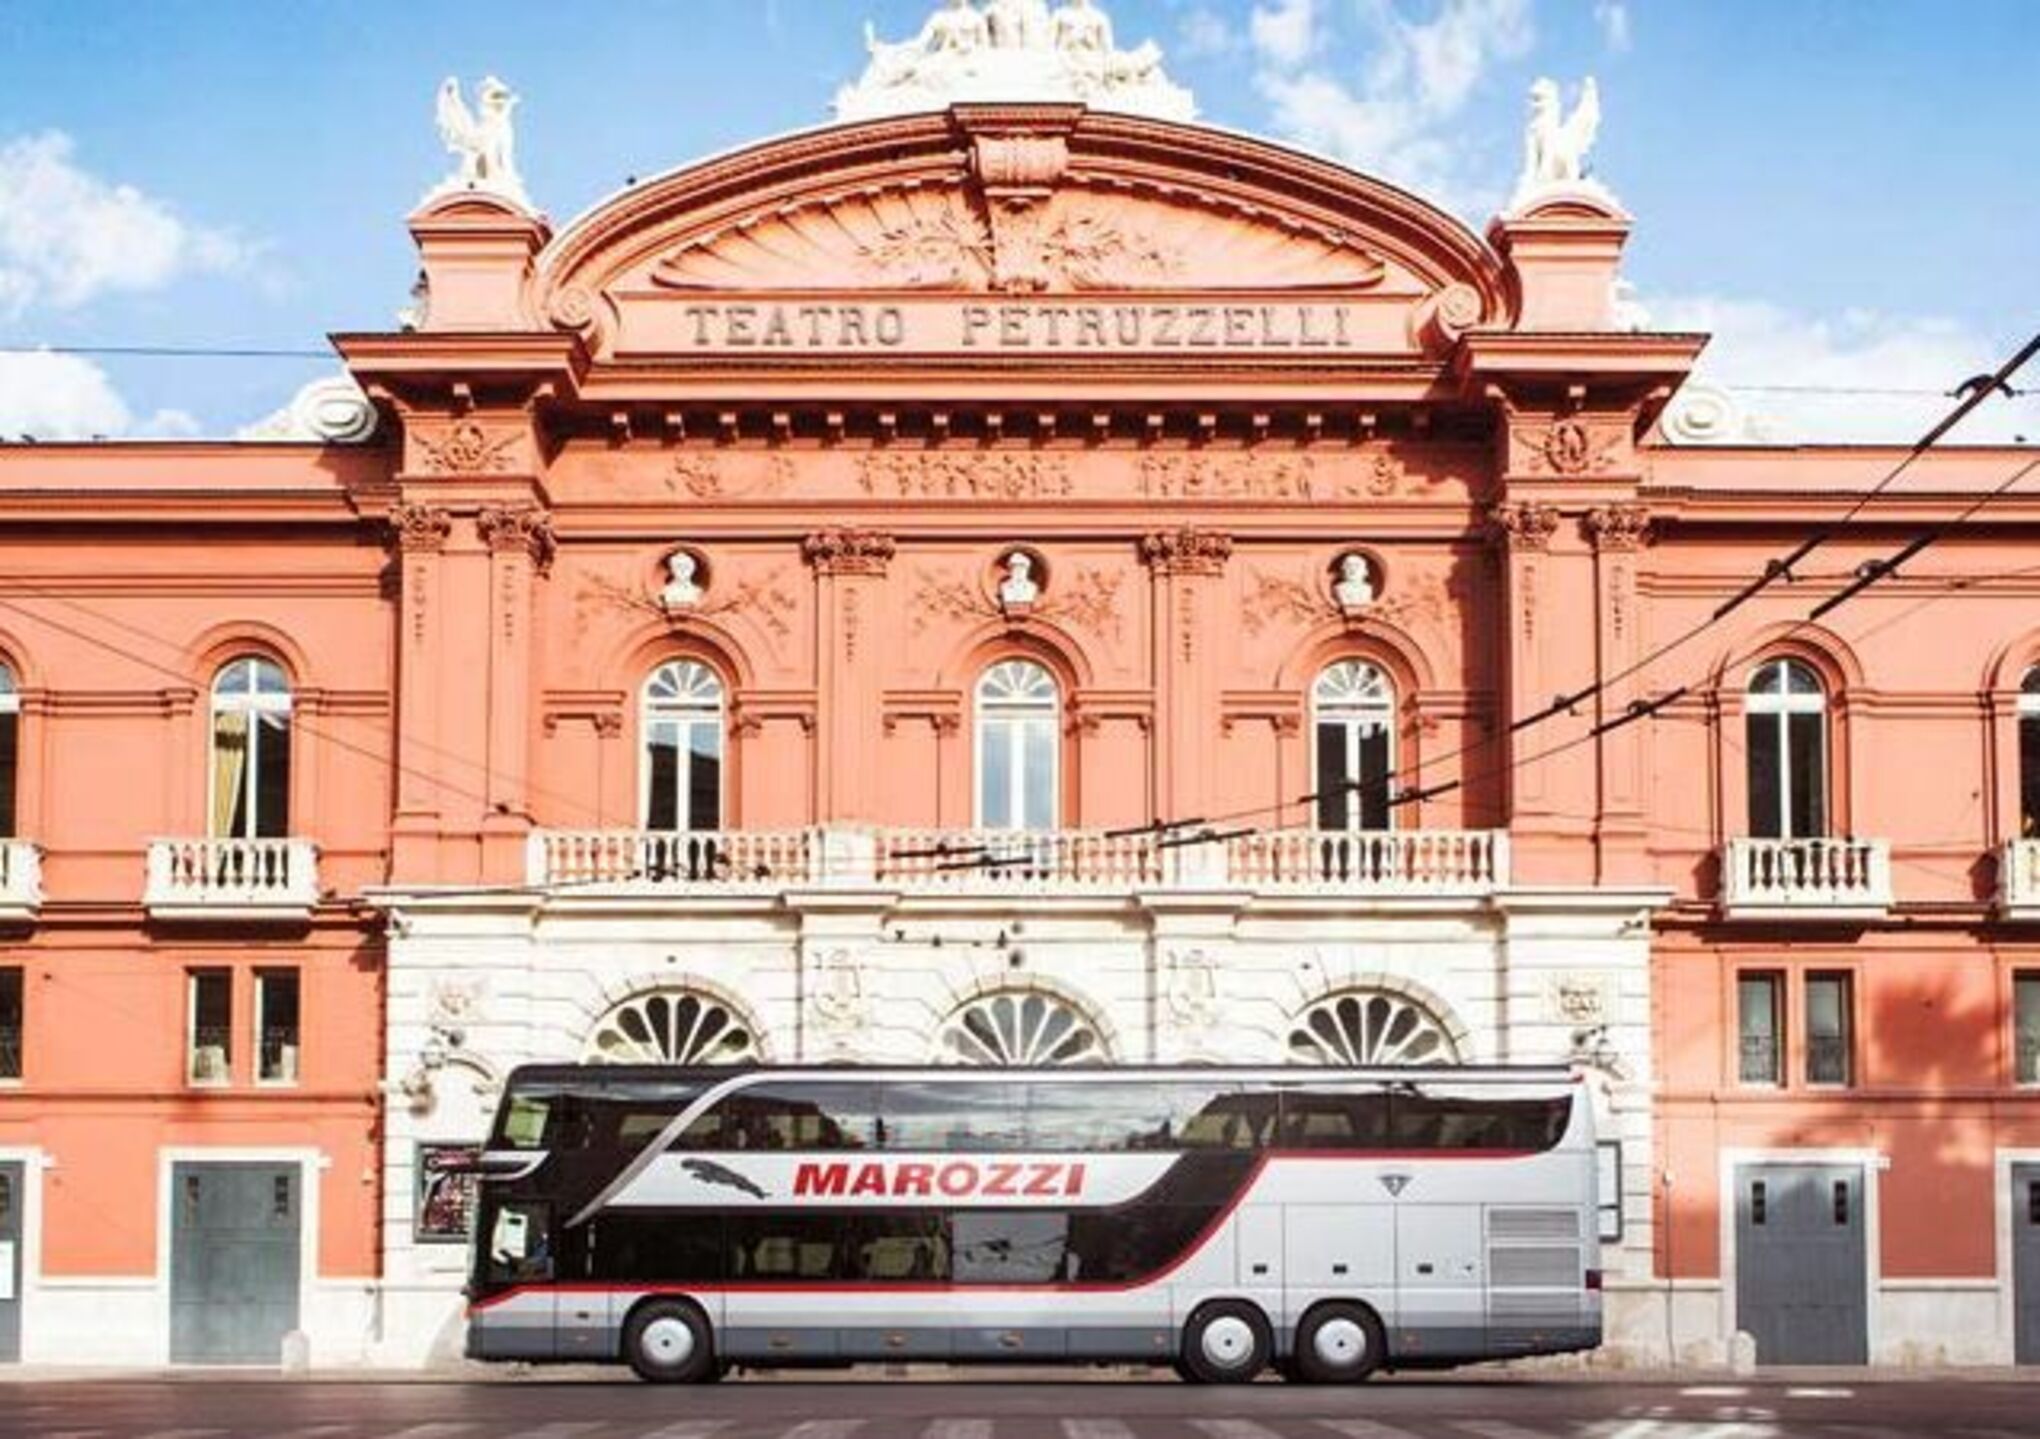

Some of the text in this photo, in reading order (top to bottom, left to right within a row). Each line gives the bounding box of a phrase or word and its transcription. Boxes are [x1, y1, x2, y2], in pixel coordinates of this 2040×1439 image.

[685, 306, 1352, 347] TEATRO PETRUZZELLI
[793, 1162, 1087, 1197] MAROZZI
